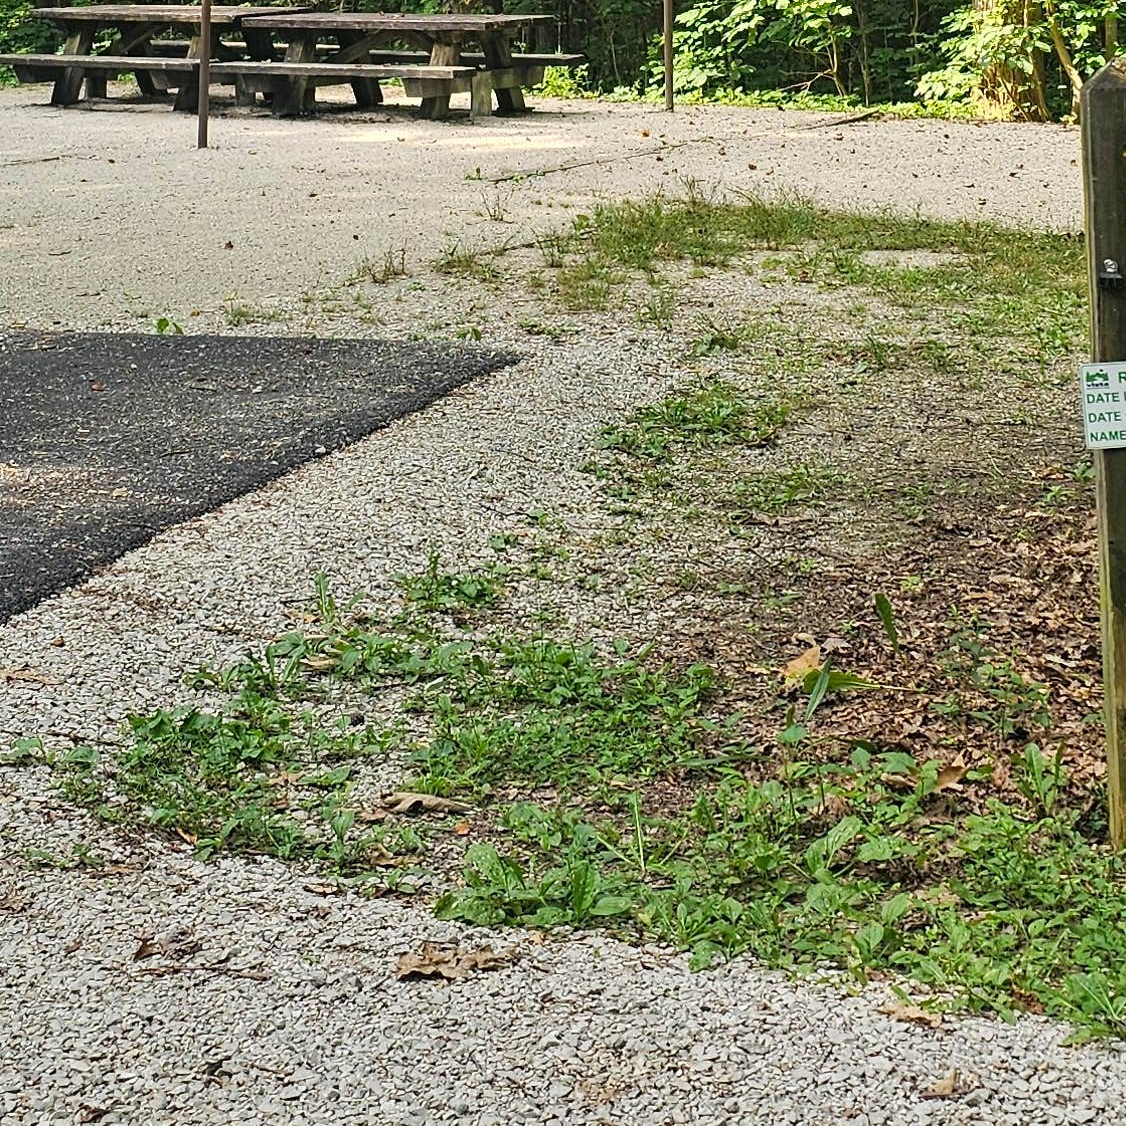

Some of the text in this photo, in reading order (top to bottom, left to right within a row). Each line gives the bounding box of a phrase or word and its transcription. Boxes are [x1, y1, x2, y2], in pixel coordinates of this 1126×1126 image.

[1087, 392, 1120, 404] DATE
[1088, 411, 1122, 423] DATE
[1090, 430, 1126, 442] NAME
